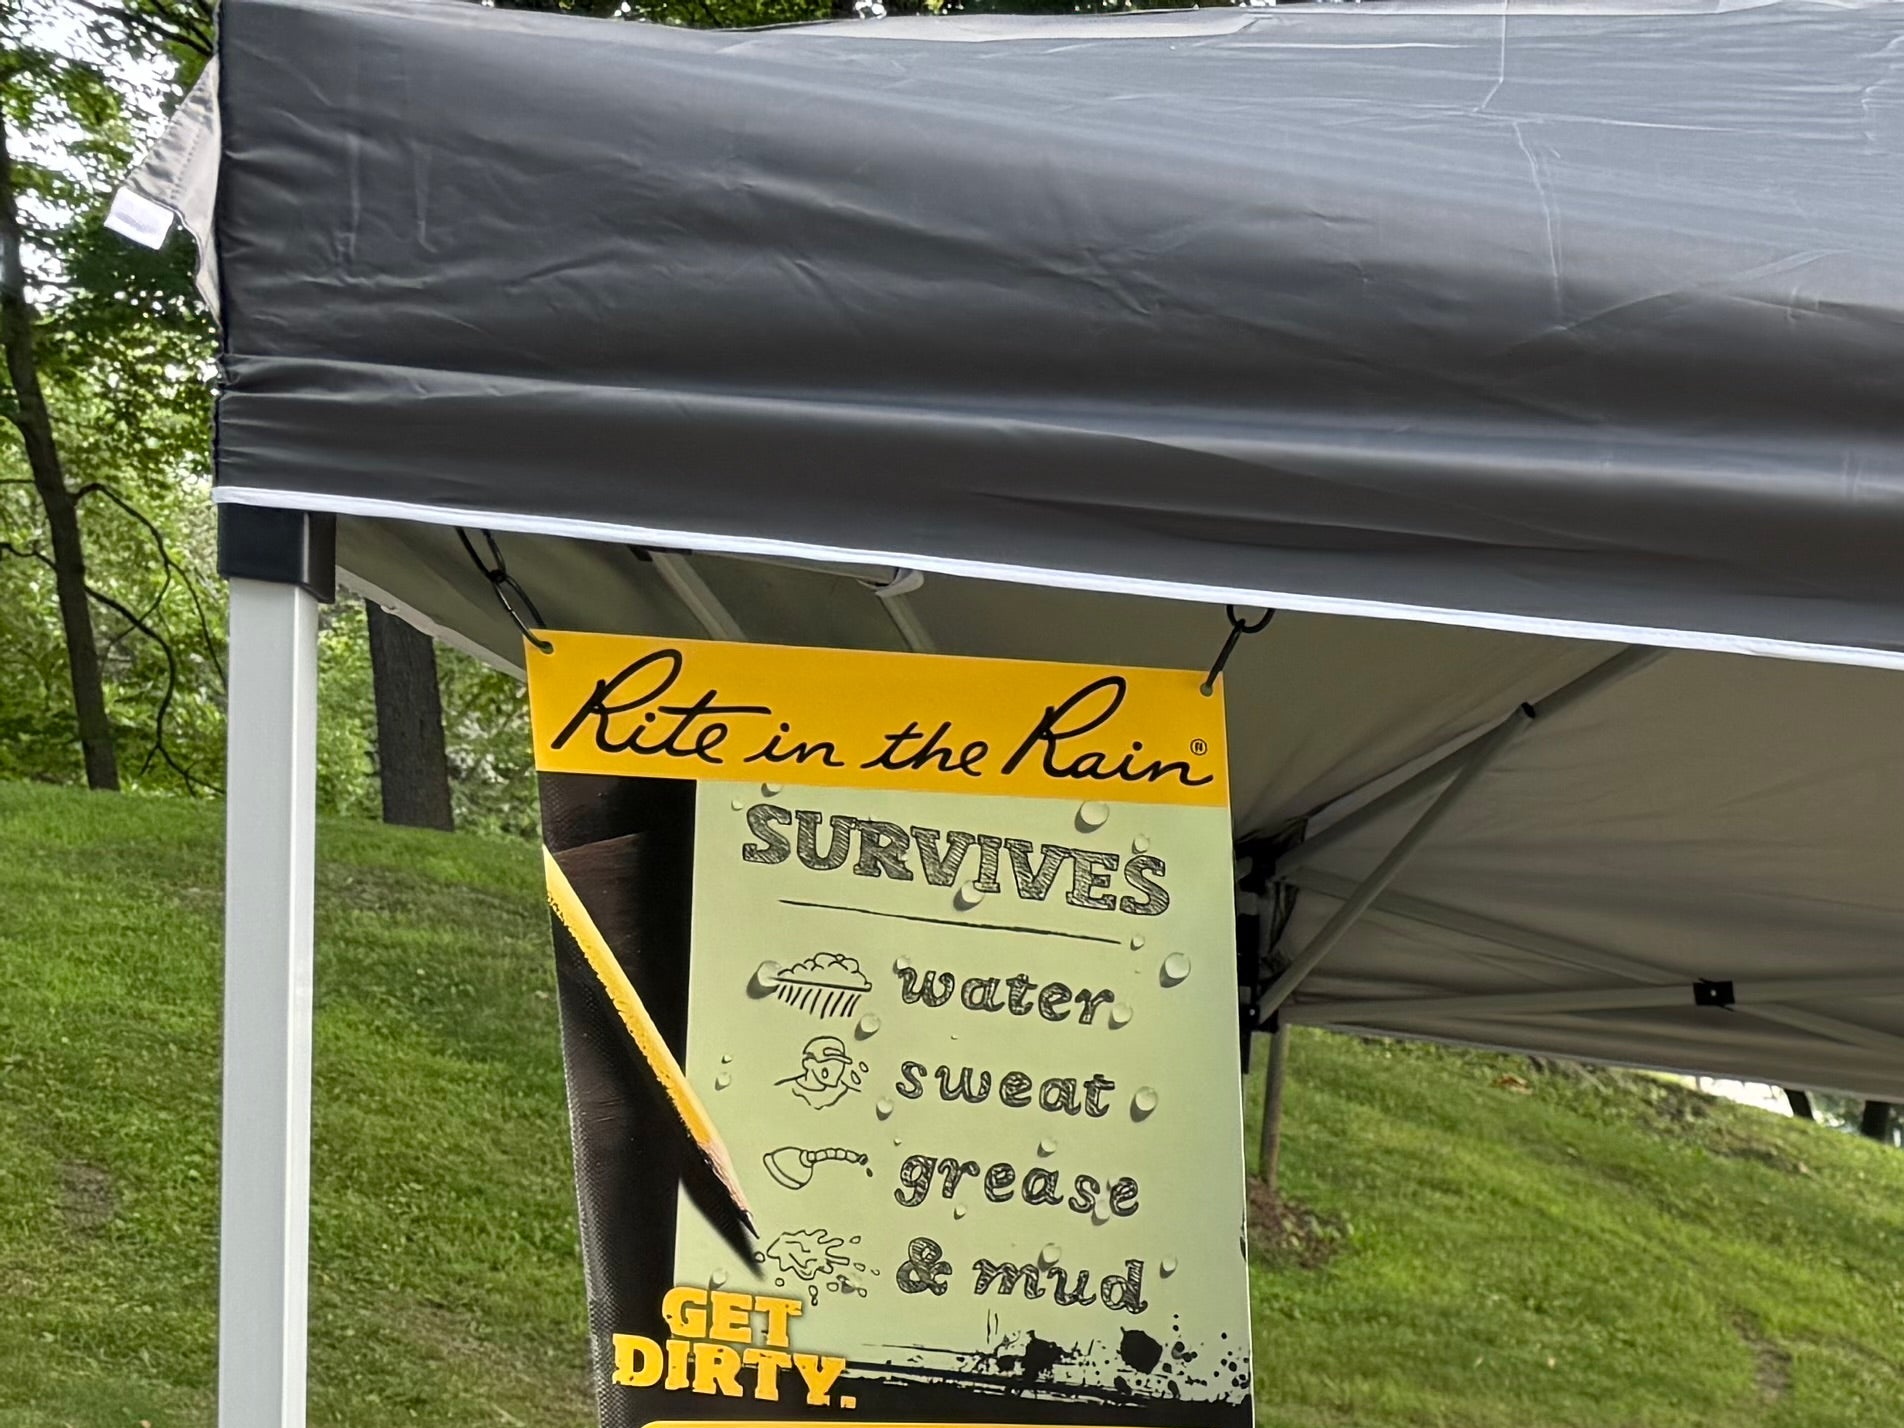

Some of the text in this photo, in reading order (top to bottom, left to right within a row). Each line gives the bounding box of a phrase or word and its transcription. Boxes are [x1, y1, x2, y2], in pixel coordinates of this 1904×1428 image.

[552, 648, 771, 761] Rite
[745, 723, 844, 768] in
[859, 722, 988, 775] the
[742, 804, 1170, 916] SURVIVES
[897, 961, 1116, 1026] water
[895, 1059, 1116, 1118] sweat
[894, 1153, 1140, 1219] grease
[896, 1237, 1148, 1315] & mud
[661, 1286, 803, 1348] GET
[611, 1333, 858, 1410] DIRTY.
